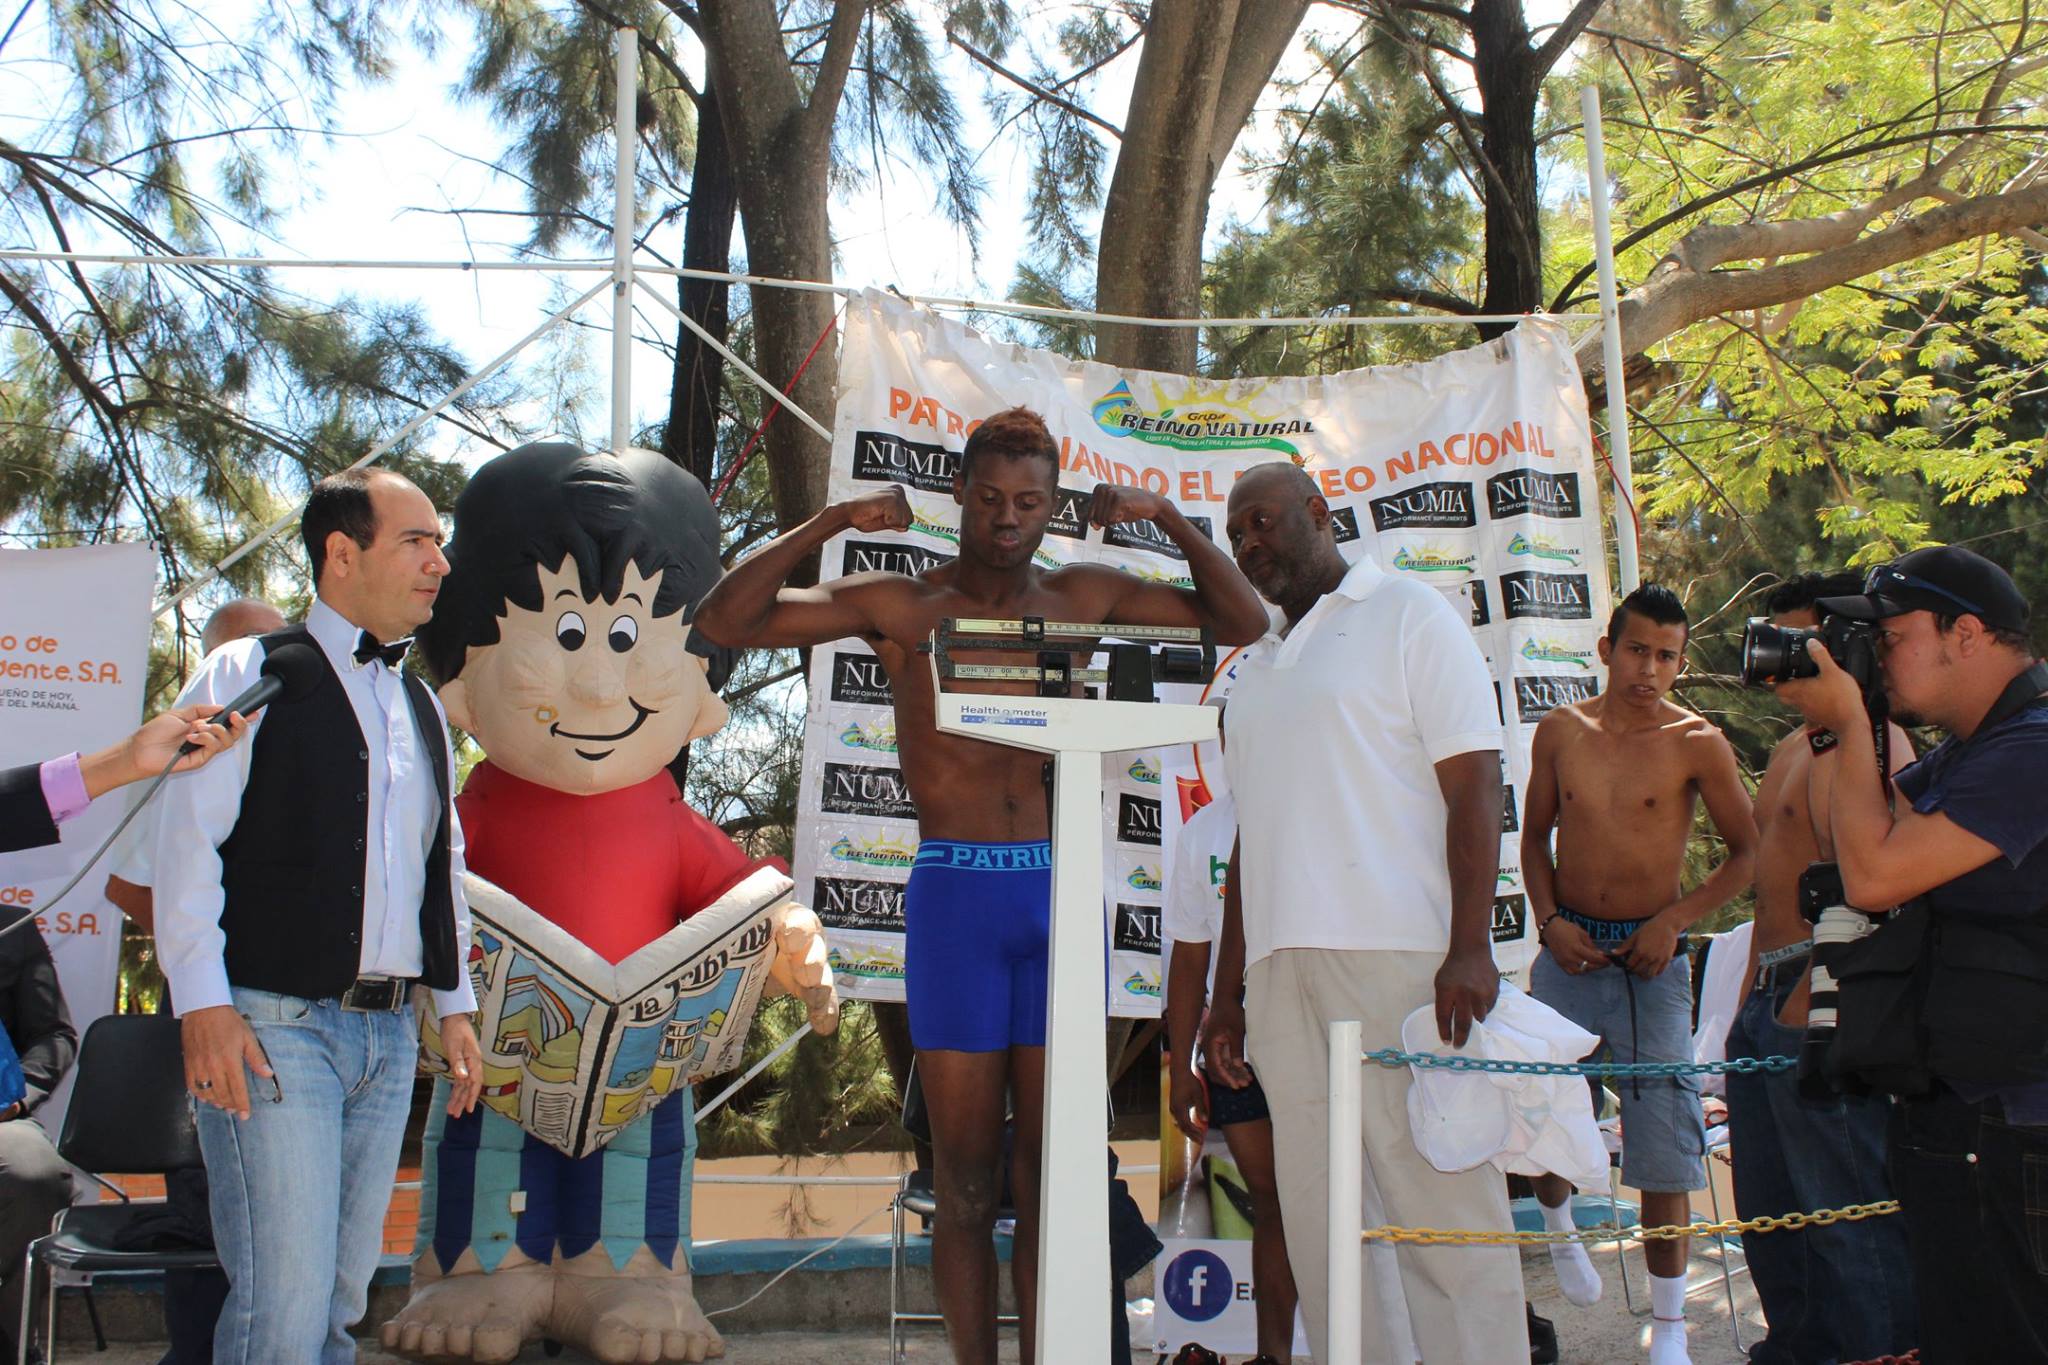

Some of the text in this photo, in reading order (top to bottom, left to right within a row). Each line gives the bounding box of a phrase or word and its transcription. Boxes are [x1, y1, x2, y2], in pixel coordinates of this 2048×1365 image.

[1385, 420, 1555, 481] NACIONAL
[1380, 488, 1467, 520] NUMIA
[1048, 520, 1079, 533] EMENTS
[854, 549, 942, 577] NUM
[25, 636, 58, 654] de
[0, 659, 122, 684] ente. S.A.
[8, 699, 28, 708] DEL
[32, 690, 46, 700] DE
[49, 692, 74, 702] HOY,
[961, 705, 1000, 715] Health
[1012, 709, 1048, 717] meter
[1812, 732, 1836, 748] Ca
[832, 771, 912, 802] NUM
[1126, 829, 1162, 839] PERFORM
[0, 887, 34, 905] de
[823, 885, 906, 916] NUM
[55, 911, 101, 935] S.A.
[1123, 938, 1162, 948] PERFORM
